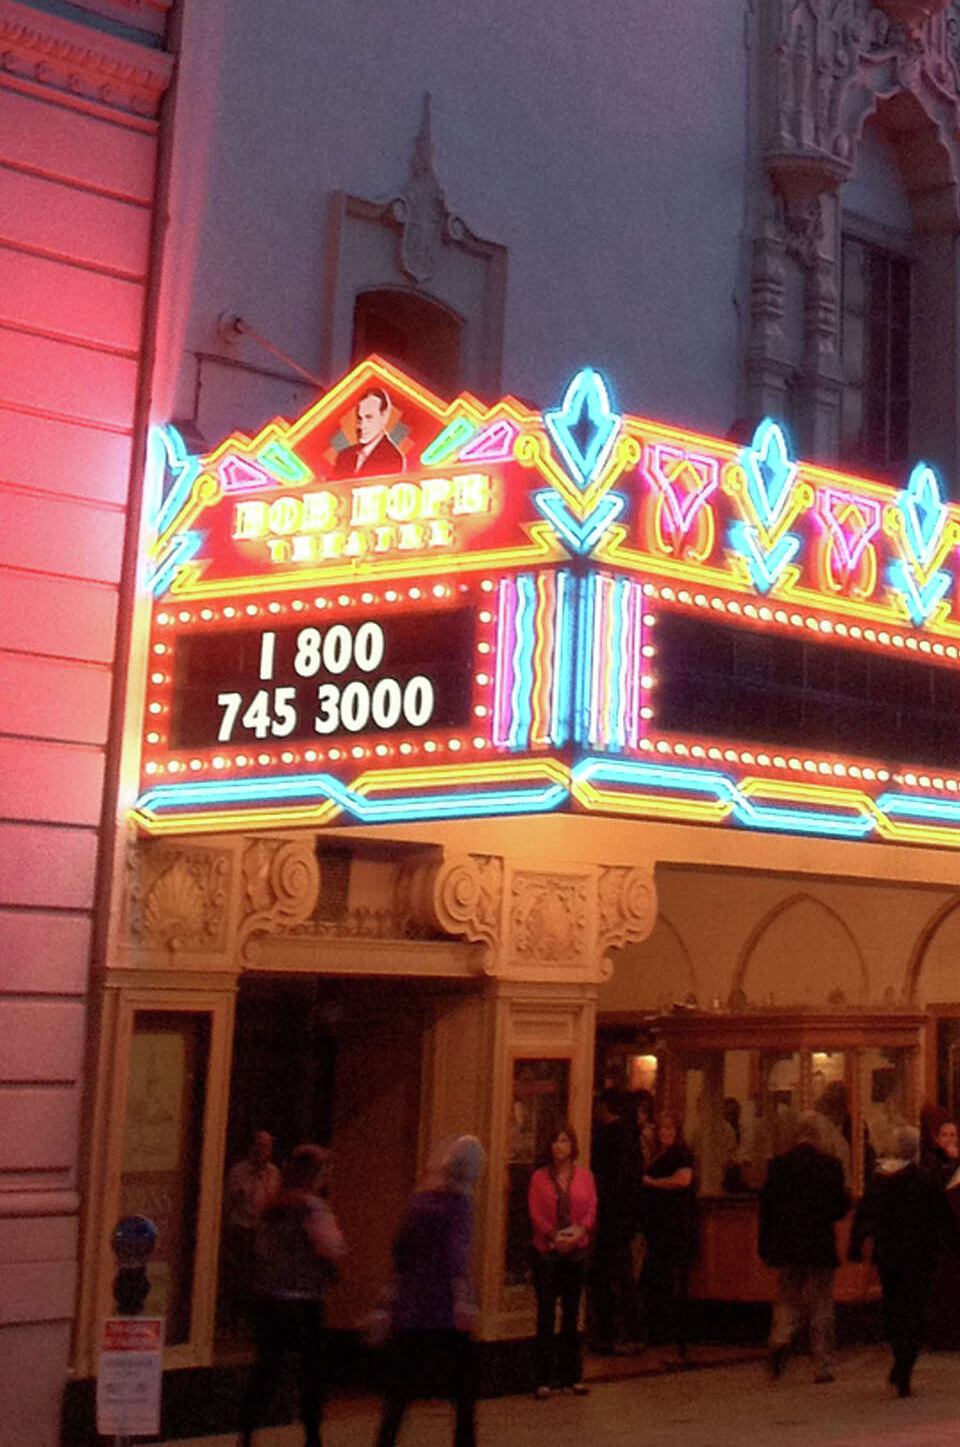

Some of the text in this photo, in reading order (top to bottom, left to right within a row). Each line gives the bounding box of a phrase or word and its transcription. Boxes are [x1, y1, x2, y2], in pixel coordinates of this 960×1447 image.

[232, 473, 490, 541] BOB HOPE
[267, 519, 455, 564] THEATRE
[257, 621, 385, 680] 1 800
[216, 674, 434, 742] 745 3000
